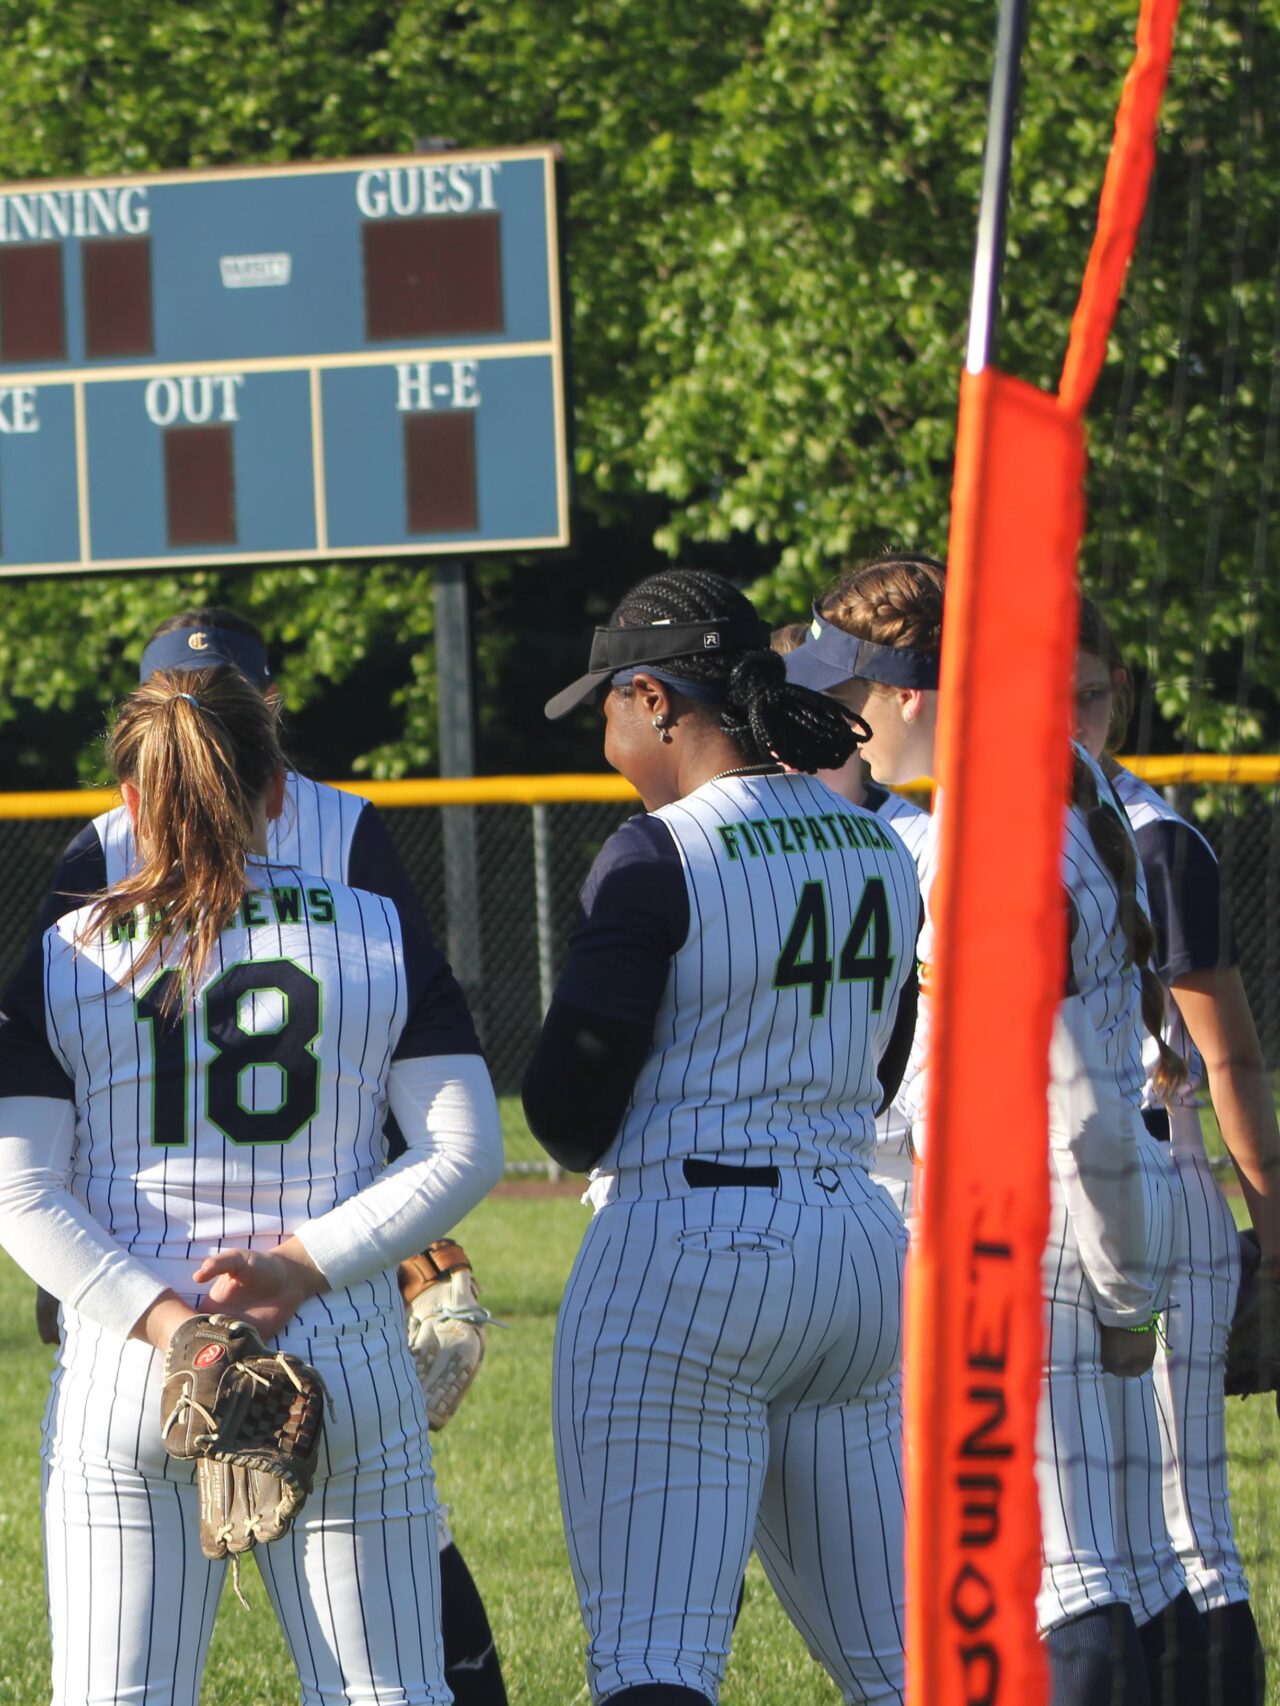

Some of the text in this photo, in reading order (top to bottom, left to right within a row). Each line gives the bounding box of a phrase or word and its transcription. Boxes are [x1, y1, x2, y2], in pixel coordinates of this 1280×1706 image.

[356, 162, 502, 218] GUEST
[144, 373, 245, 426] OUT
[396, 359, 481, 411] H-E
[716, 812, 896, 861] FITZPATRICK
[771, 876, 897, 1019] 44
[134, 956, 323, 1147] 18
